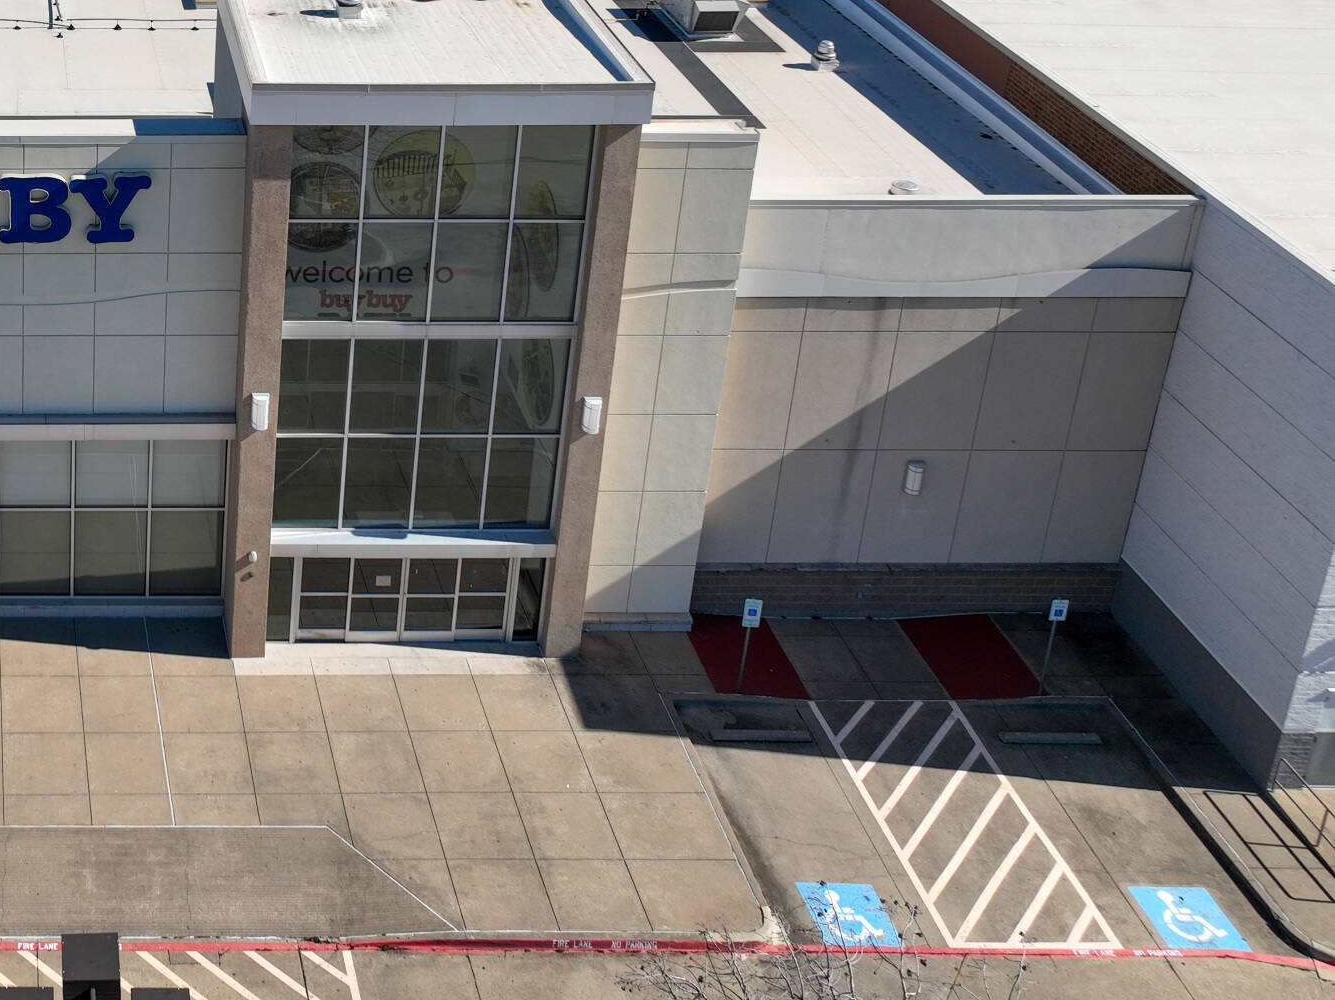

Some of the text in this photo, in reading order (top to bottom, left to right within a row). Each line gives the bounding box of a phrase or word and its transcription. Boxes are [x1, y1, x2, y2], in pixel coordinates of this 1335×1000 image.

[285, 260, 454, 284] welcome to
[17, 942, 59, 950] FIRE LANE
[552, 939, 658, 949] FIRE LANE NO PARKING
